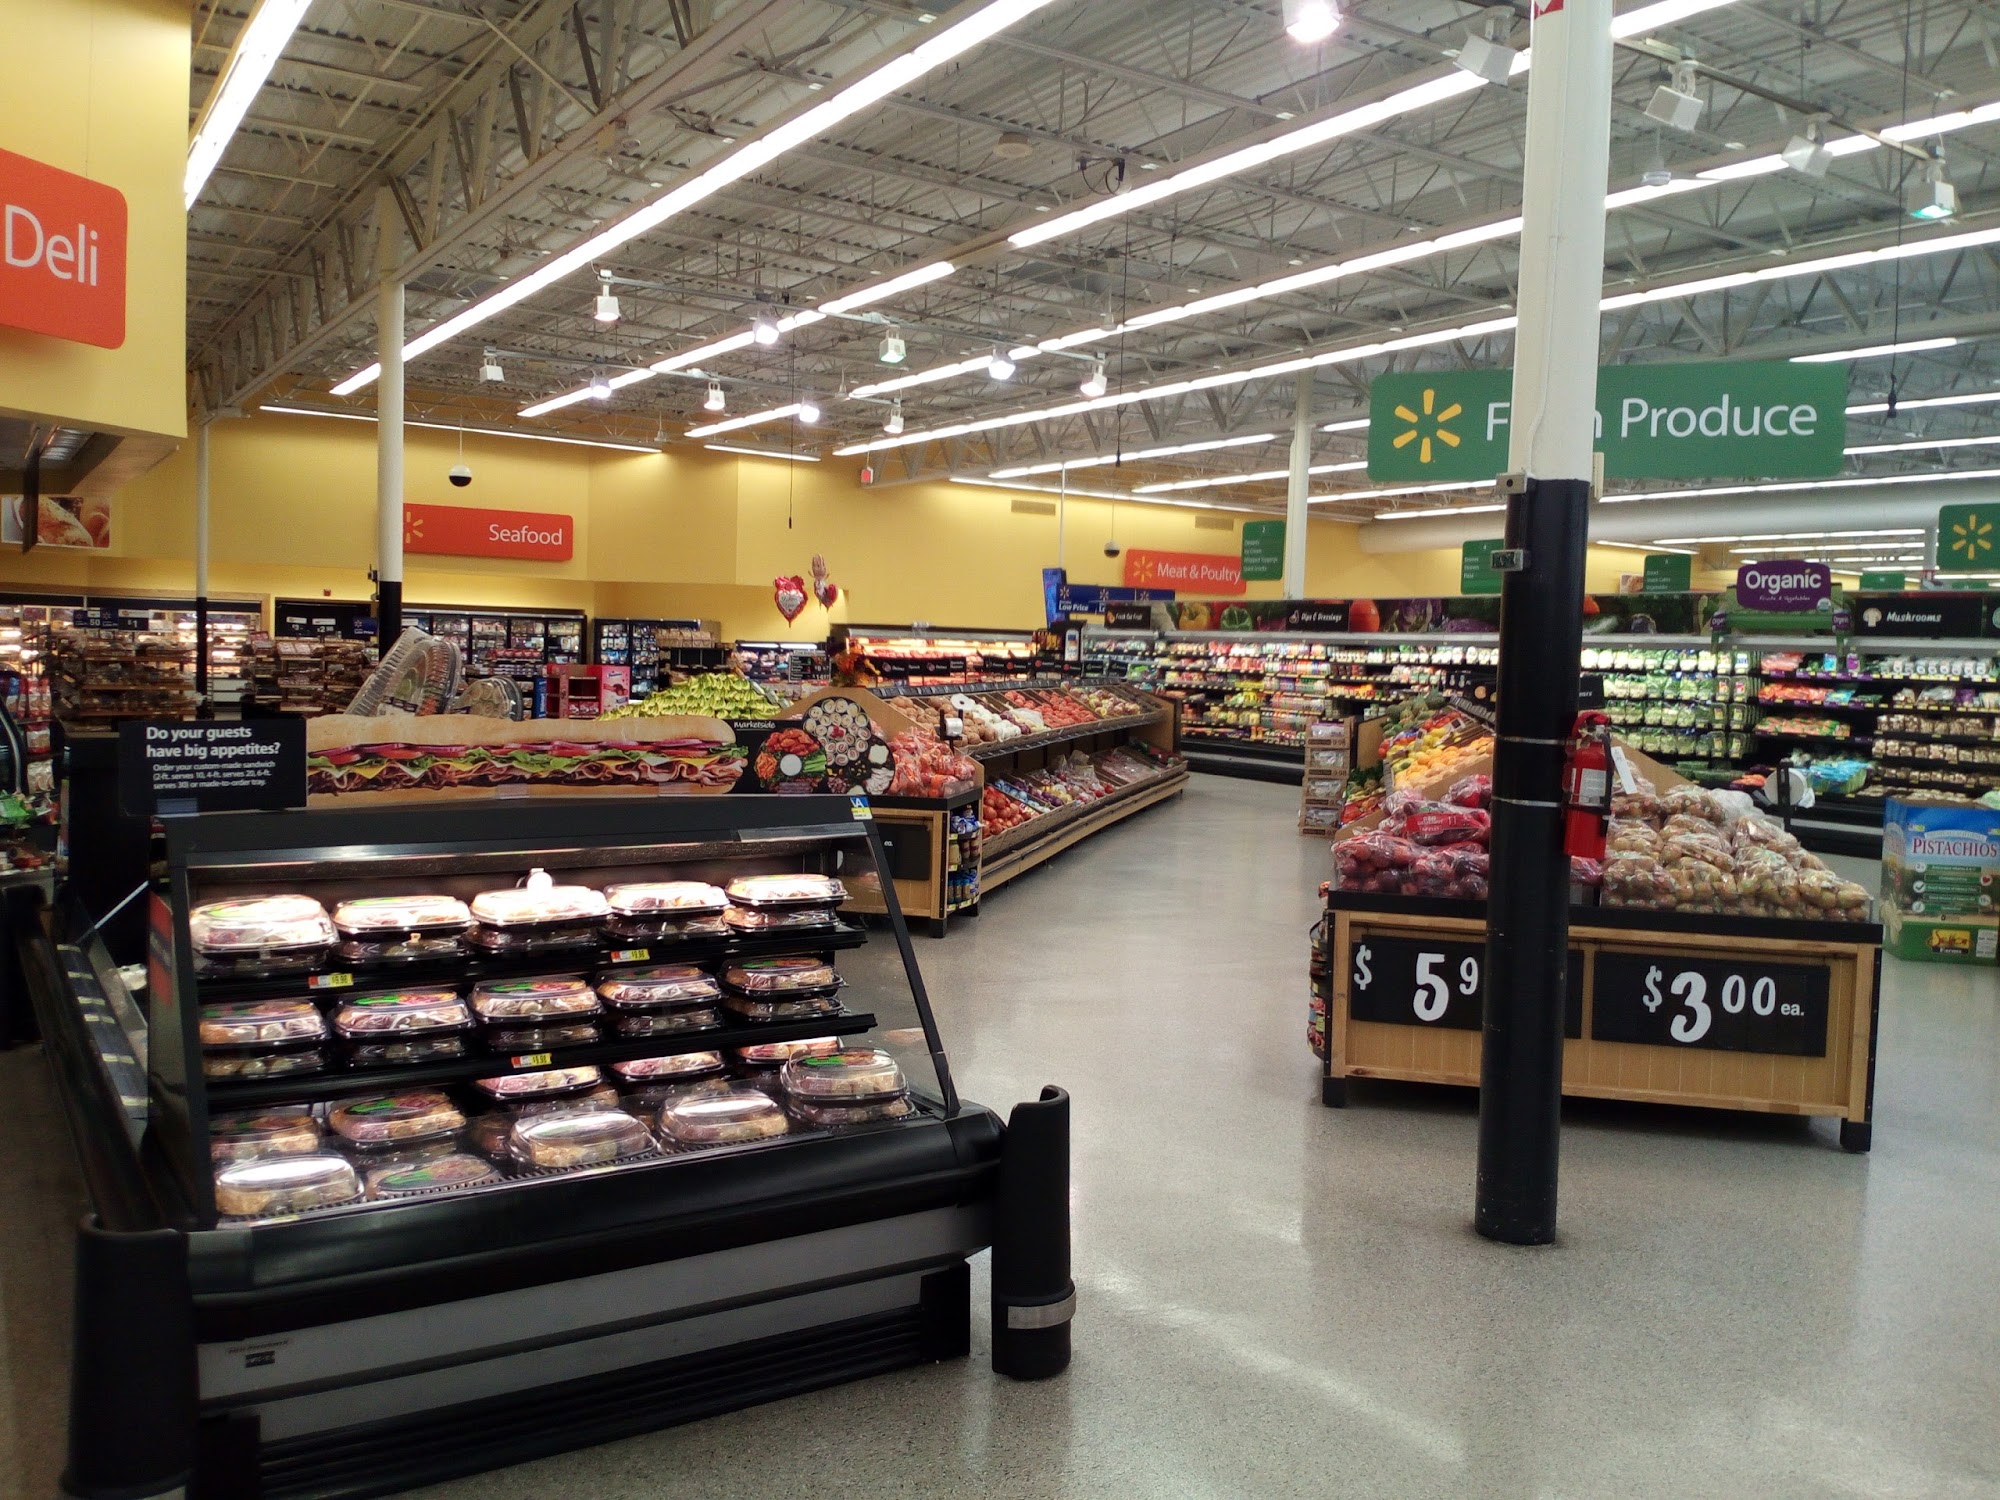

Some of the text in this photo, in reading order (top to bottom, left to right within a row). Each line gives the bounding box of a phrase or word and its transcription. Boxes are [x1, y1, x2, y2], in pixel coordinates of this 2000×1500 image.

[5, 203, 98, 287] Deli
[1621, 393, 1819, 439] Produce
[488, 523, 563, 546] Seafood
[1157, 563, 1242, 585] Meat & Poultry
[1745, 568, 1822, 595] Organic
[1073, 603, 1089, 612] Price
[1886, 611, 1942, 623] Mushrooms
[733, 720, 776, 729] Marketside
[146, 726, 253, 743] Do your guests
[146, 742, 281, 760] have big appetites?
[175, 764, 192, 772] your
[1913, 837, 1998, 858] PISTACHIOS
[1780, 1002, 1805, 1016] ea.
